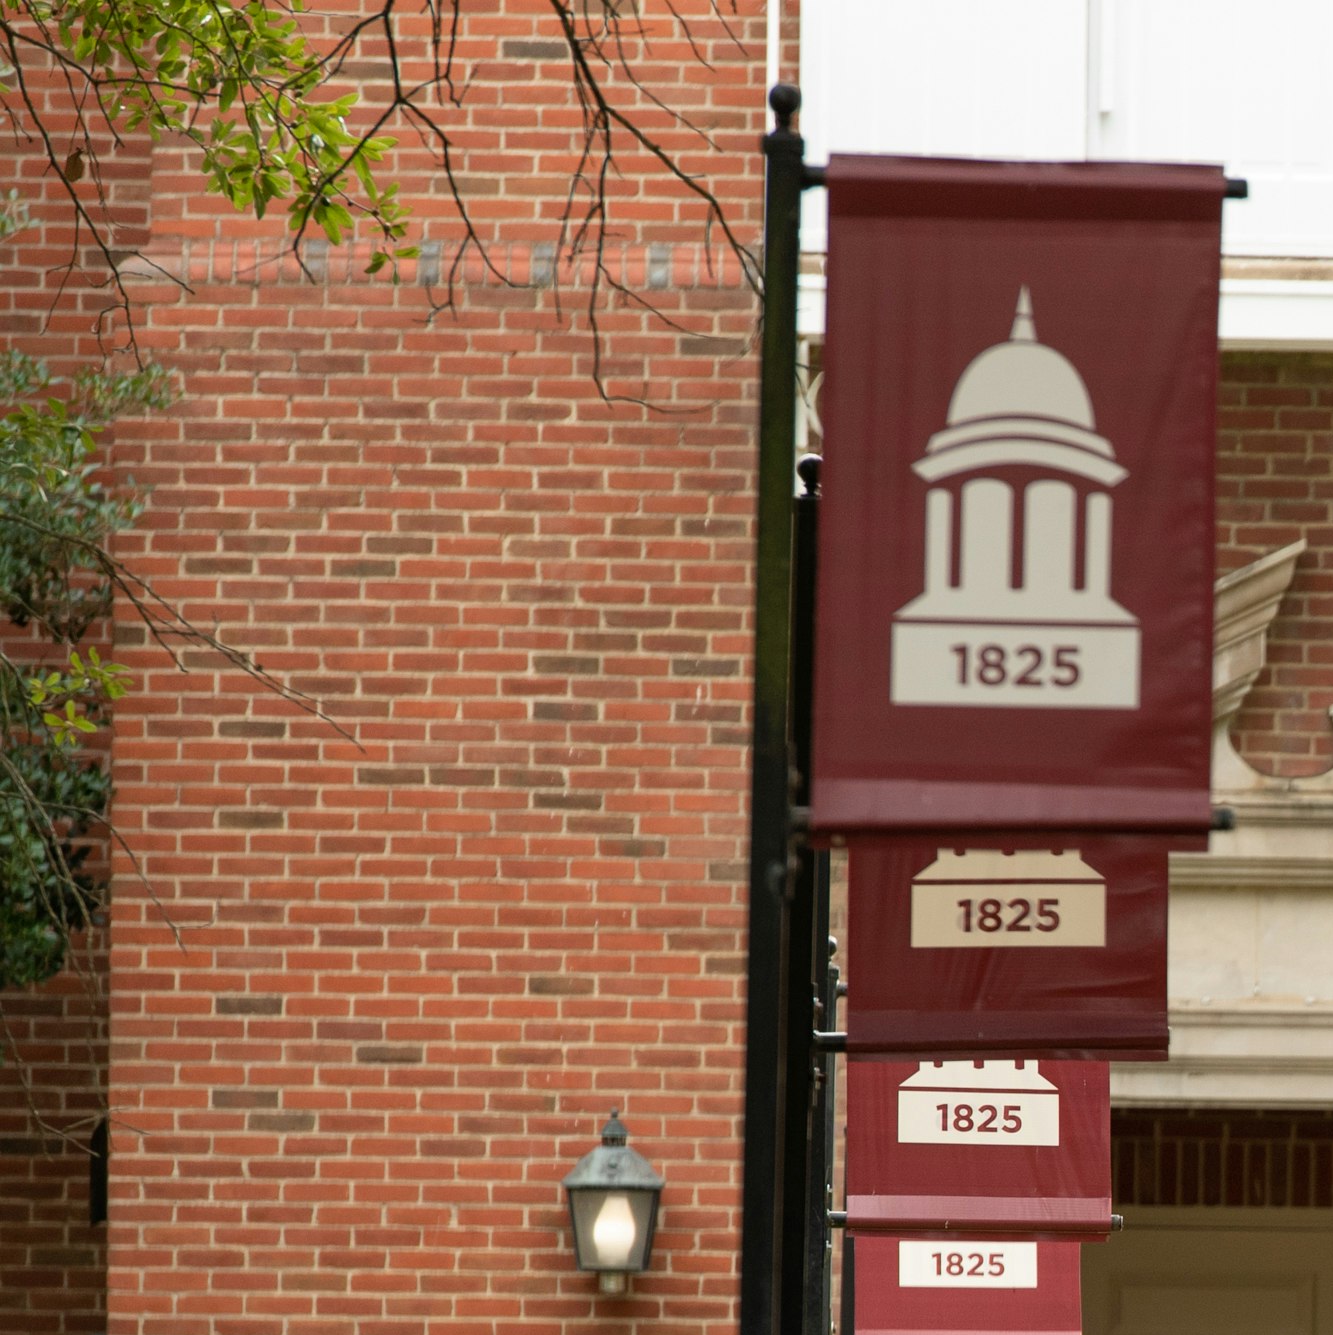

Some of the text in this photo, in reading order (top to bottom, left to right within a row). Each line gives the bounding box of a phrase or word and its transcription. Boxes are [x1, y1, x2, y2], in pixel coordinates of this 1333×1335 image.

[951, 643, 1083, 689] 1825
[957, 897, 1062, 934] 1825
[935, 1103, 1024, 1134] 1825
[931, 1252, 1006, 1278] 1825
